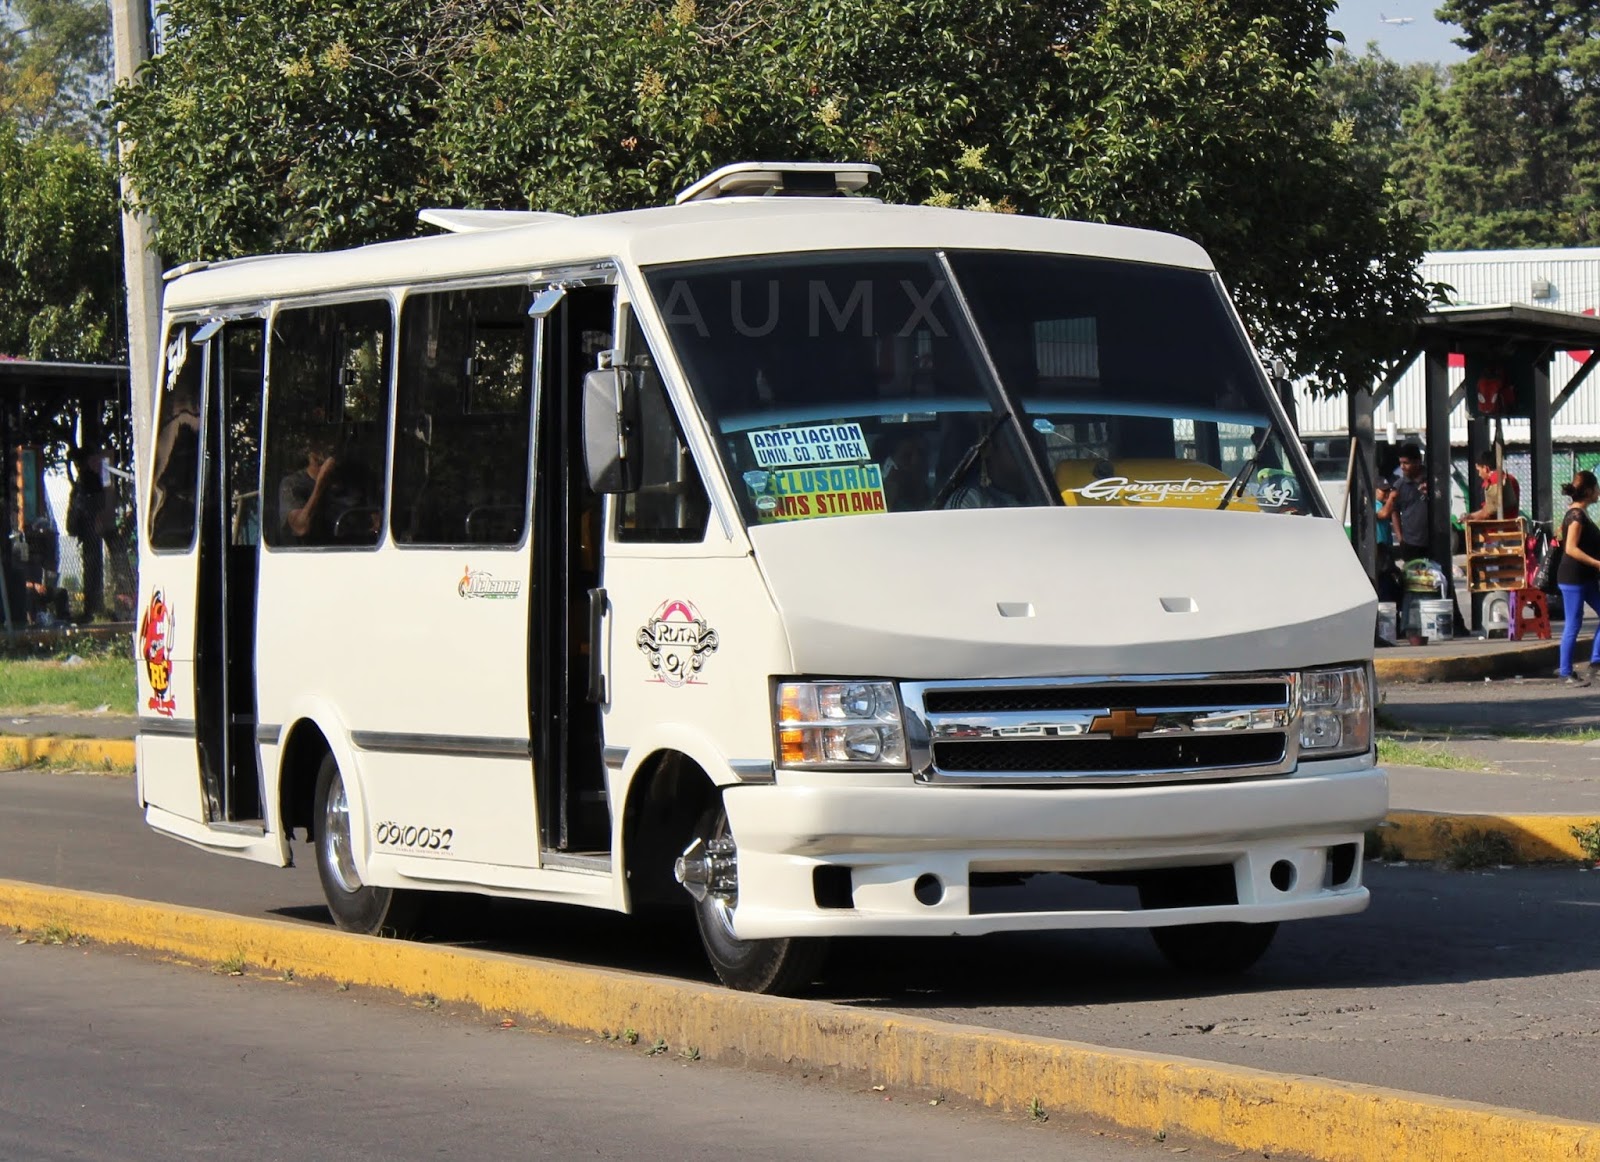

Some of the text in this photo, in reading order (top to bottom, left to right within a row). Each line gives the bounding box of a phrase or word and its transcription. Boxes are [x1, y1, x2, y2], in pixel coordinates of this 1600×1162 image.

[753, 425, 862, 448] AMPLIACION
[758, 442, 867, 464] UNIV. CD. DE MEX.
[753, 467, 881, 495] ECLUSORIO
[1067, 477, 1217, 503] Gangster
[658, 624, 698, 643] RUTA
[376, 822, 454, 851] 0910052
